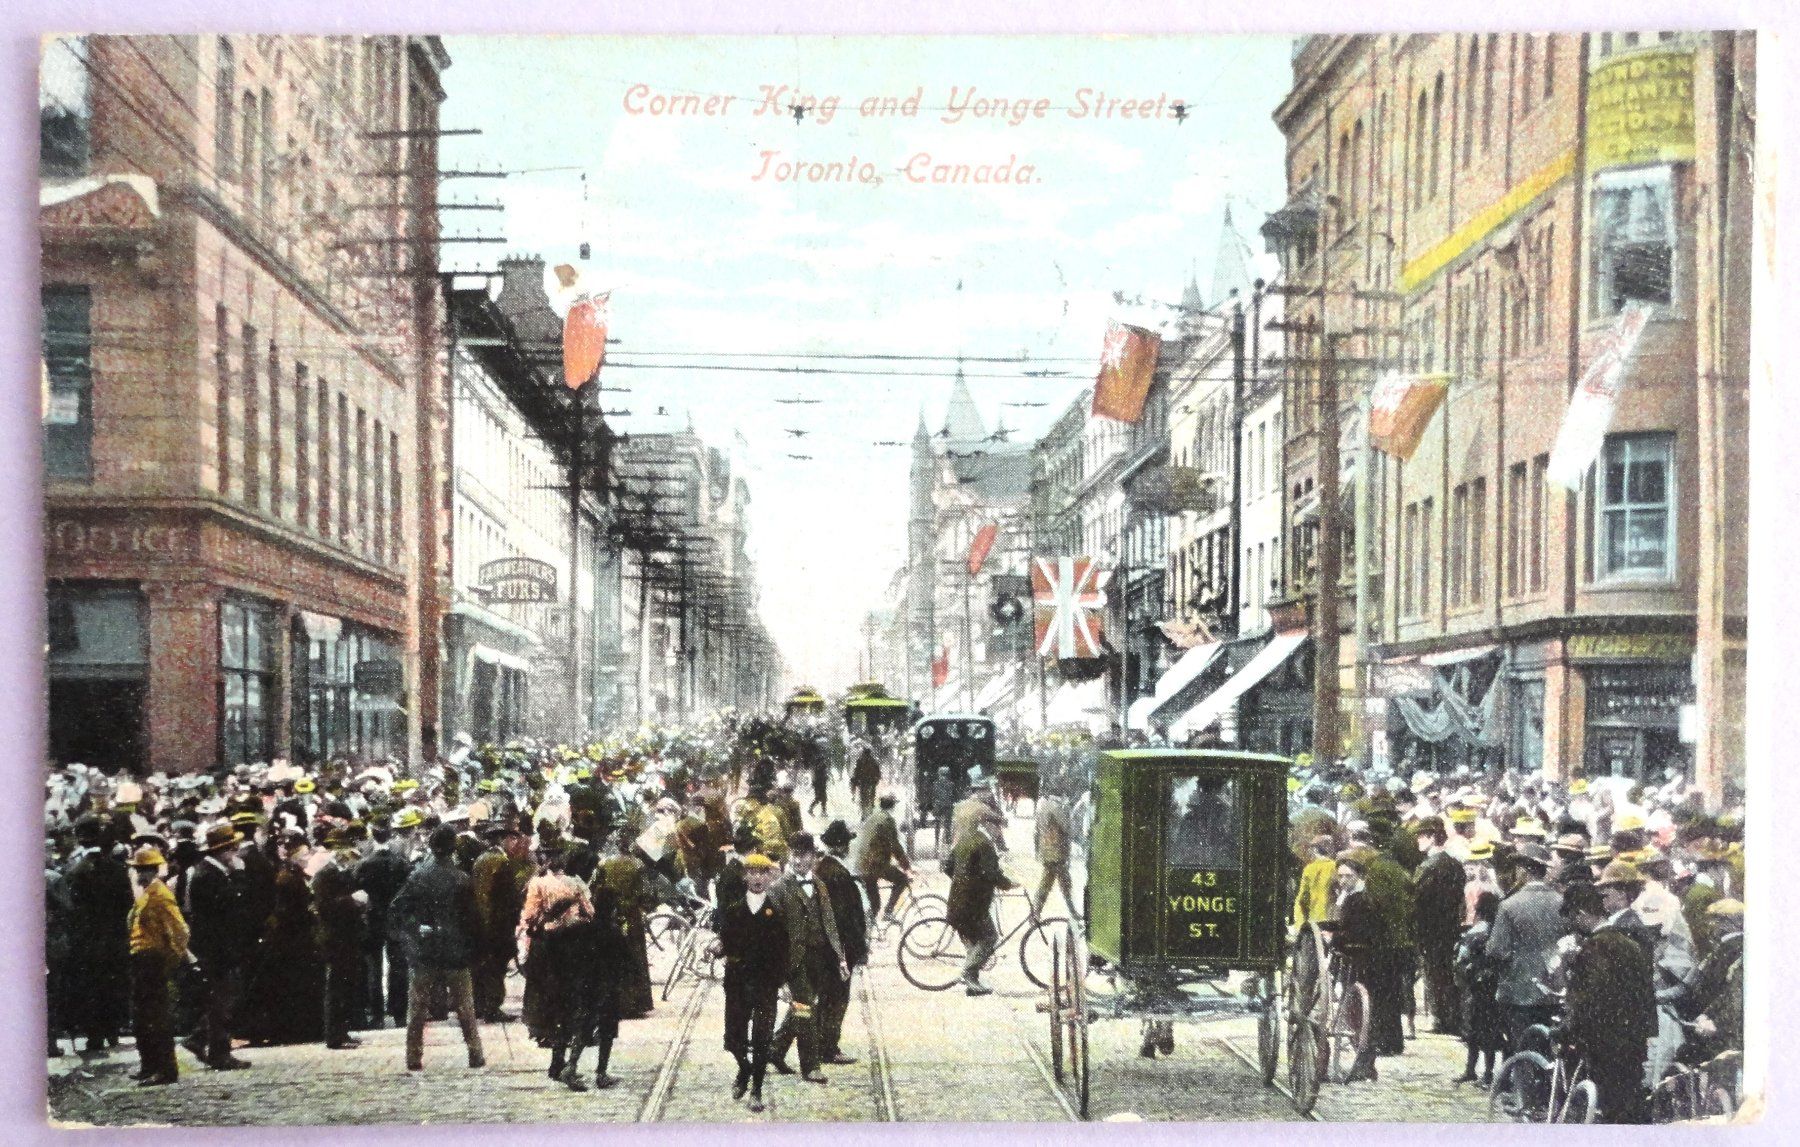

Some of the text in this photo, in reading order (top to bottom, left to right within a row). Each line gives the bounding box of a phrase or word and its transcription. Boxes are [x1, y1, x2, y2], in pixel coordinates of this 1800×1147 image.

[1191, 871, 1217, 887] 43
[1167, 894, 1237, 914] YONGE
[1189, 922, 1220, 938] ST.
